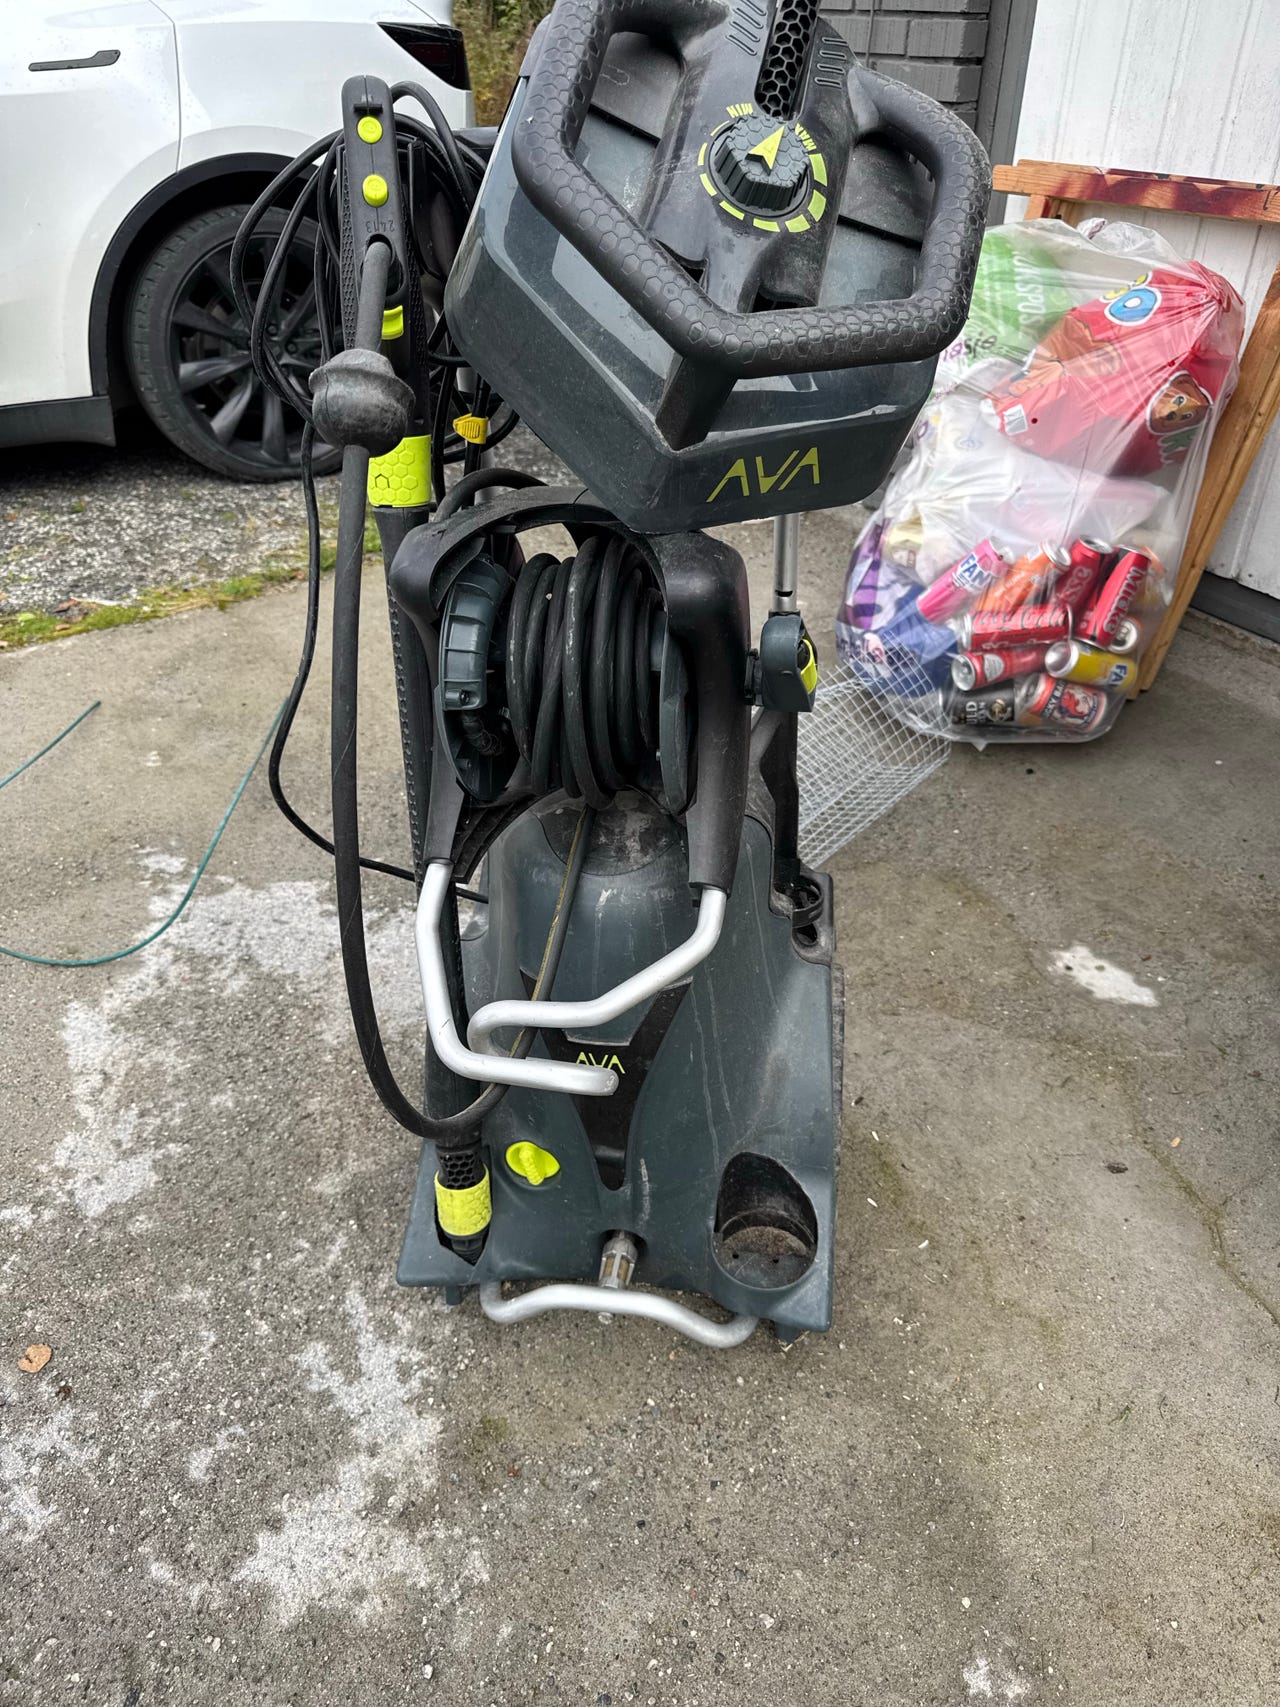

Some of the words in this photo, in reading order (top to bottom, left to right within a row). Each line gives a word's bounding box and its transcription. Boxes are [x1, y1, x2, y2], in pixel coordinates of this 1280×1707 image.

[726, 103, 753, 119] MIN
[706, 446, 820, 503] AVA
[576, 1051, 626, 1075] AVA
